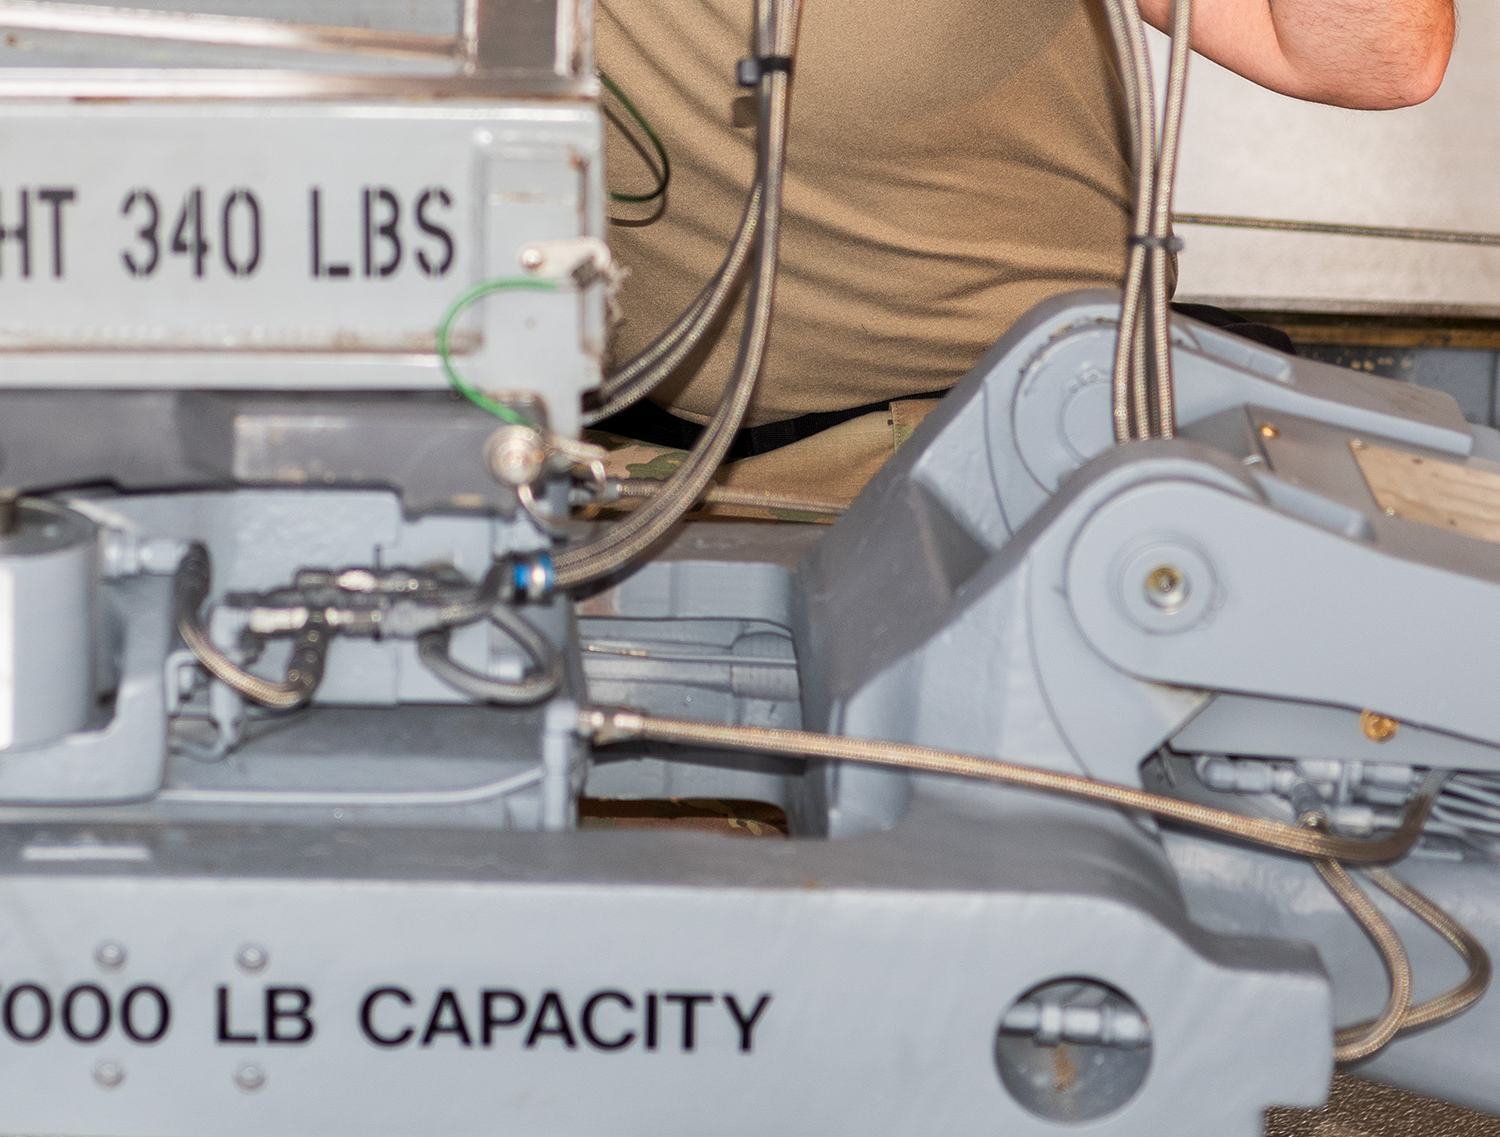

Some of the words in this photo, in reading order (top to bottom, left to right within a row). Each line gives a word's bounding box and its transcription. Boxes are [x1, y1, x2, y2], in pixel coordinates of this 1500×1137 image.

[121, 187, 262, 278] 340
[311, 188, 455, 278] LBS
[215, 984, 316, 1046] LB
[357, 985, 773, 1054] CAPACITY
